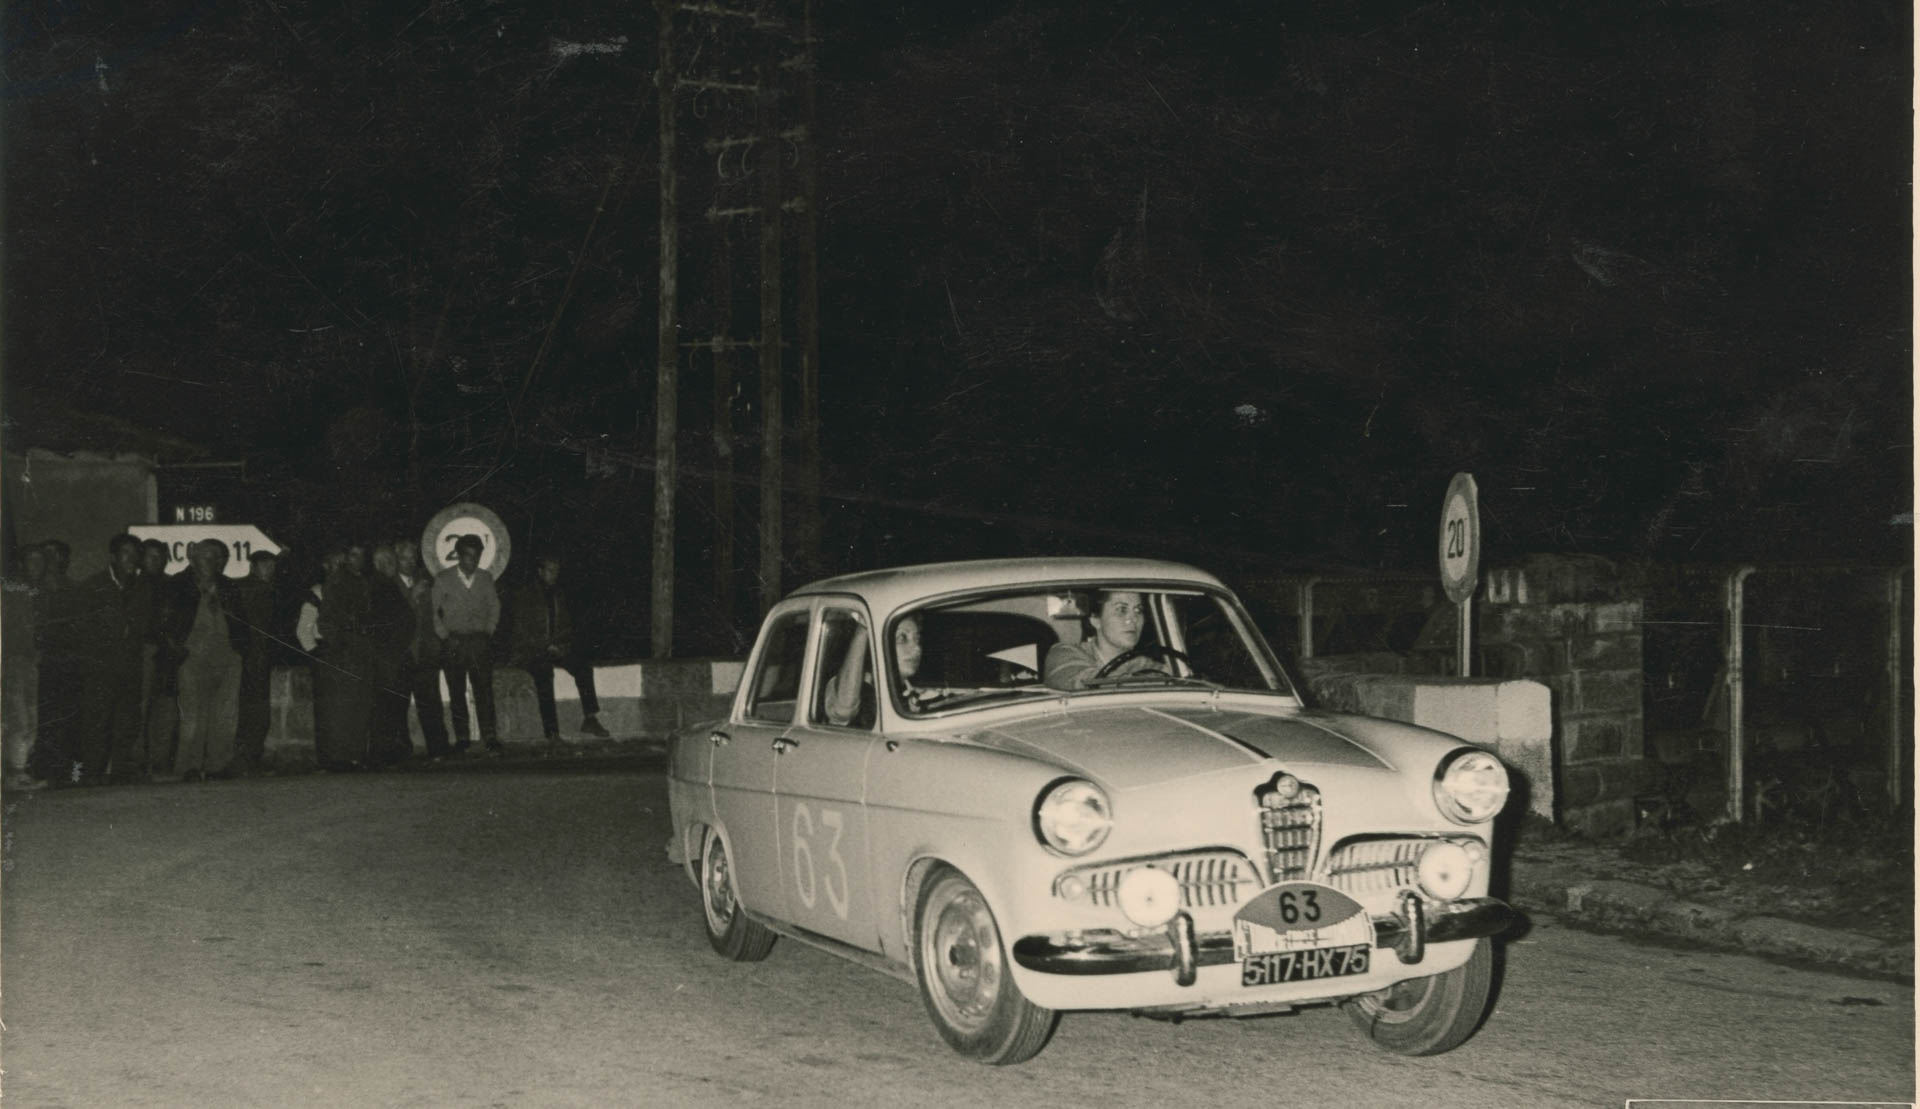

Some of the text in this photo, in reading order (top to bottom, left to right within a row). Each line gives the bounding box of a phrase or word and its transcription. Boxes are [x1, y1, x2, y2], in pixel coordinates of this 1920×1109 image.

[175, 506, 214, 522] N 196
[232, 541, 251, 562] 11
[793, 802, 848, 920] 63
[1278, 890, 1321, 924] 63
